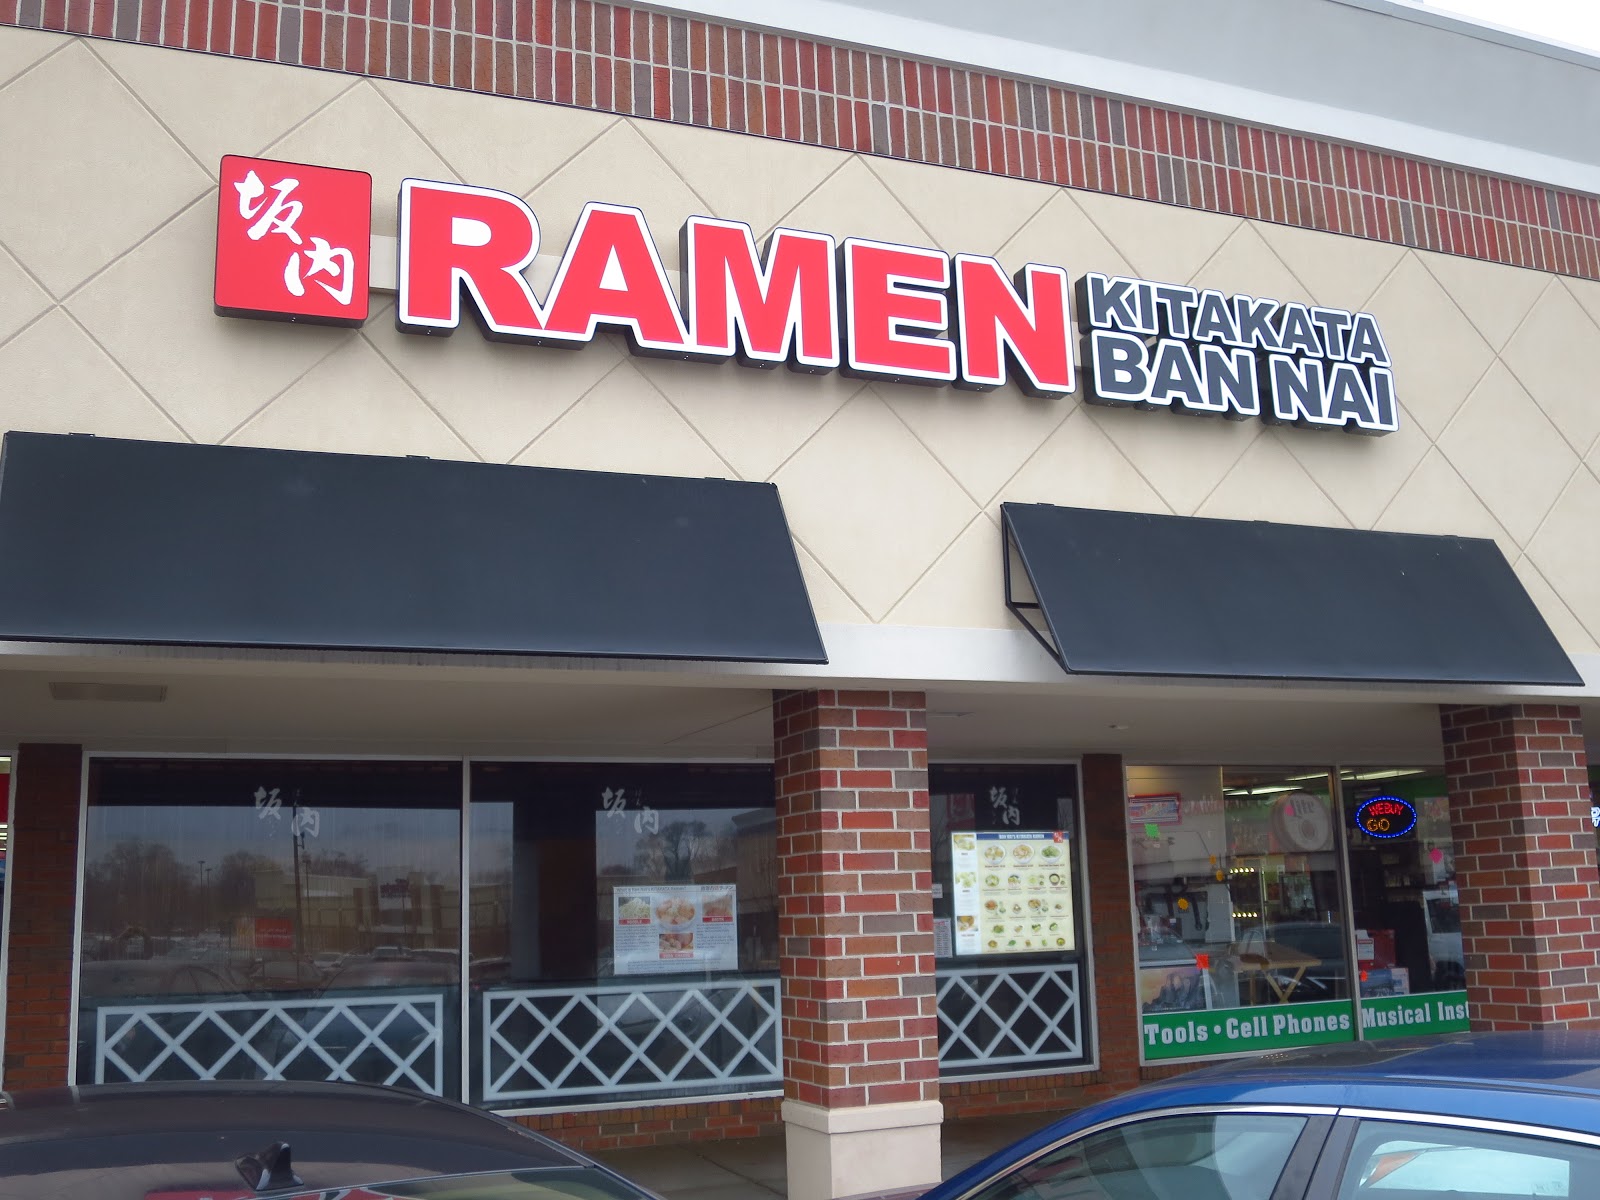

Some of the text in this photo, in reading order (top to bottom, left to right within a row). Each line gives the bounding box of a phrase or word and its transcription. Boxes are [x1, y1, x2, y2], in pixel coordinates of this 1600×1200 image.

[234, 170, 355, 305] 坂内
[398, 177, 1076, 394] RAMEN
[1086, 272, 1393, 368] KITAKATA
[1091, 329, 1399, 432] BAN NAI
[1144, 1020, 1209, 1046] Tools
[1226, 1015, 1268, 1039] Cell
[1273, 1012, 1351, 1036] Phones
[1361, 1003, 1432, 1029] Musical
